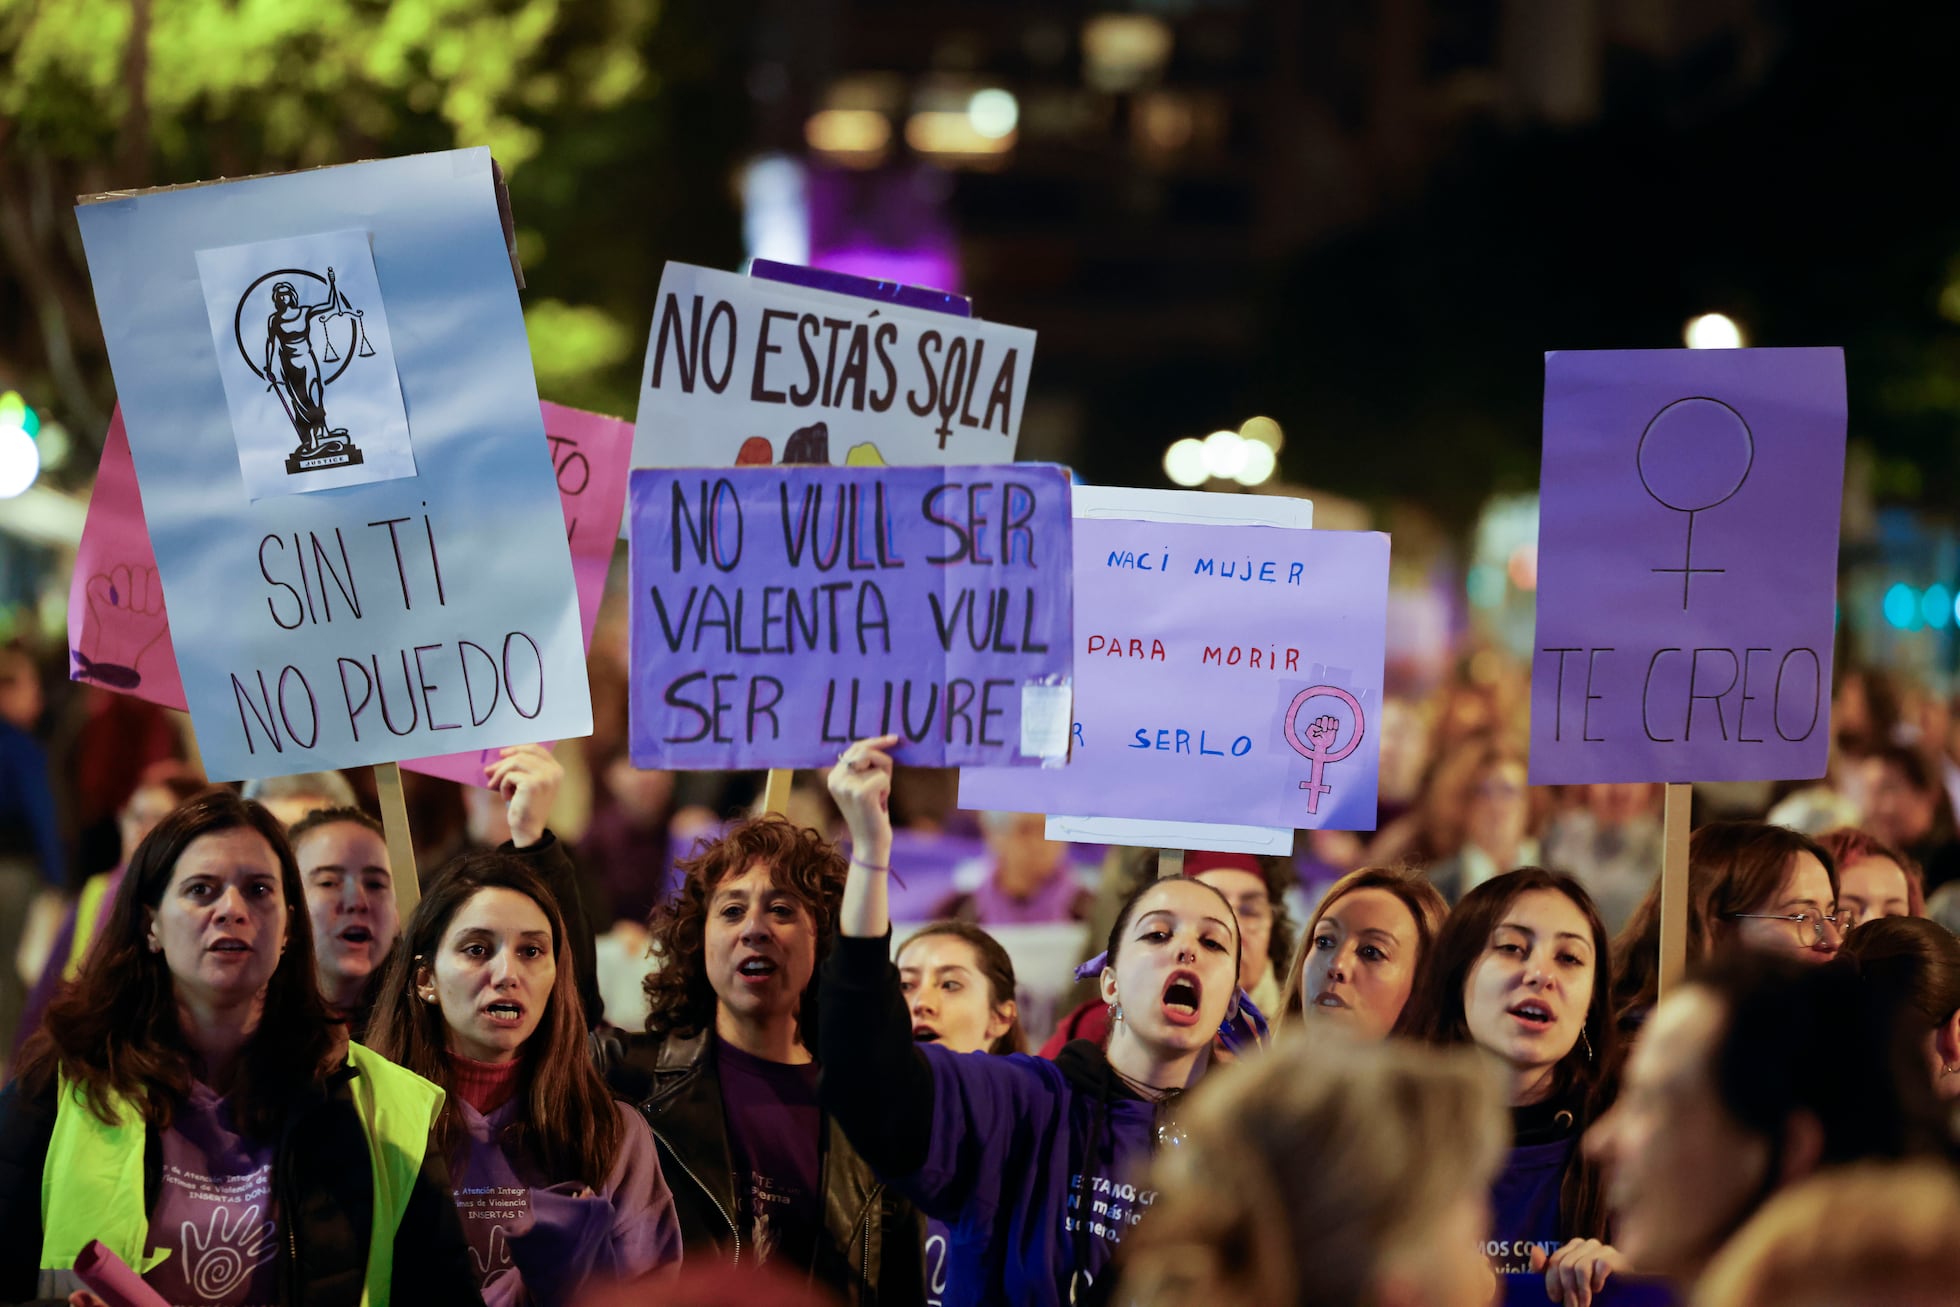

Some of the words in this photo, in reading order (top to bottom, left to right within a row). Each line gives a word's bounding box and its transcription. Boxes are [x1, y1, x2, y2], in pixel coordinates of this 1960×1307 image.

[651, 292, 737, 395] NO
[750, 309, 898, 413] ESTÁS
[907, 329, 1018, 450] SOLA
[547, 435, 589, 496] TO
[672, 477, 744, 573] NO
[780, 479, 905, 572] VULL
[922, 482, 1038, 569] SER
[258, 526, 363, 631] SIN
[651, 580, 891, 655] VALENTA
[928, 586, 1049, 655] VULL
[1087, 634, 1166, 662] PARA
[230, 665, 319, 755] NO
[336, 631, 544, 742] PUEDO
[663, 671, 784, 744] SER
[821, 678, 1015, 748] LLIURE
[1542, 647, 1616, 743] TE
[1641, 646, 1821, 744] CREO
[1128, 726, 1252, 758] SERLO
[189, 1191, 242, 1203] INSERTAS
[462, 1185, 496, 1195] Atención
[497, 1187, 526, 1196] Integr
[489, 1199, 527, 1207] Violencia
[1092, 1200, 1122, 1220] más
[468, 1211, 515, 1219] INSERTAS
[1513, 1240, 1560, 1257] CONT
